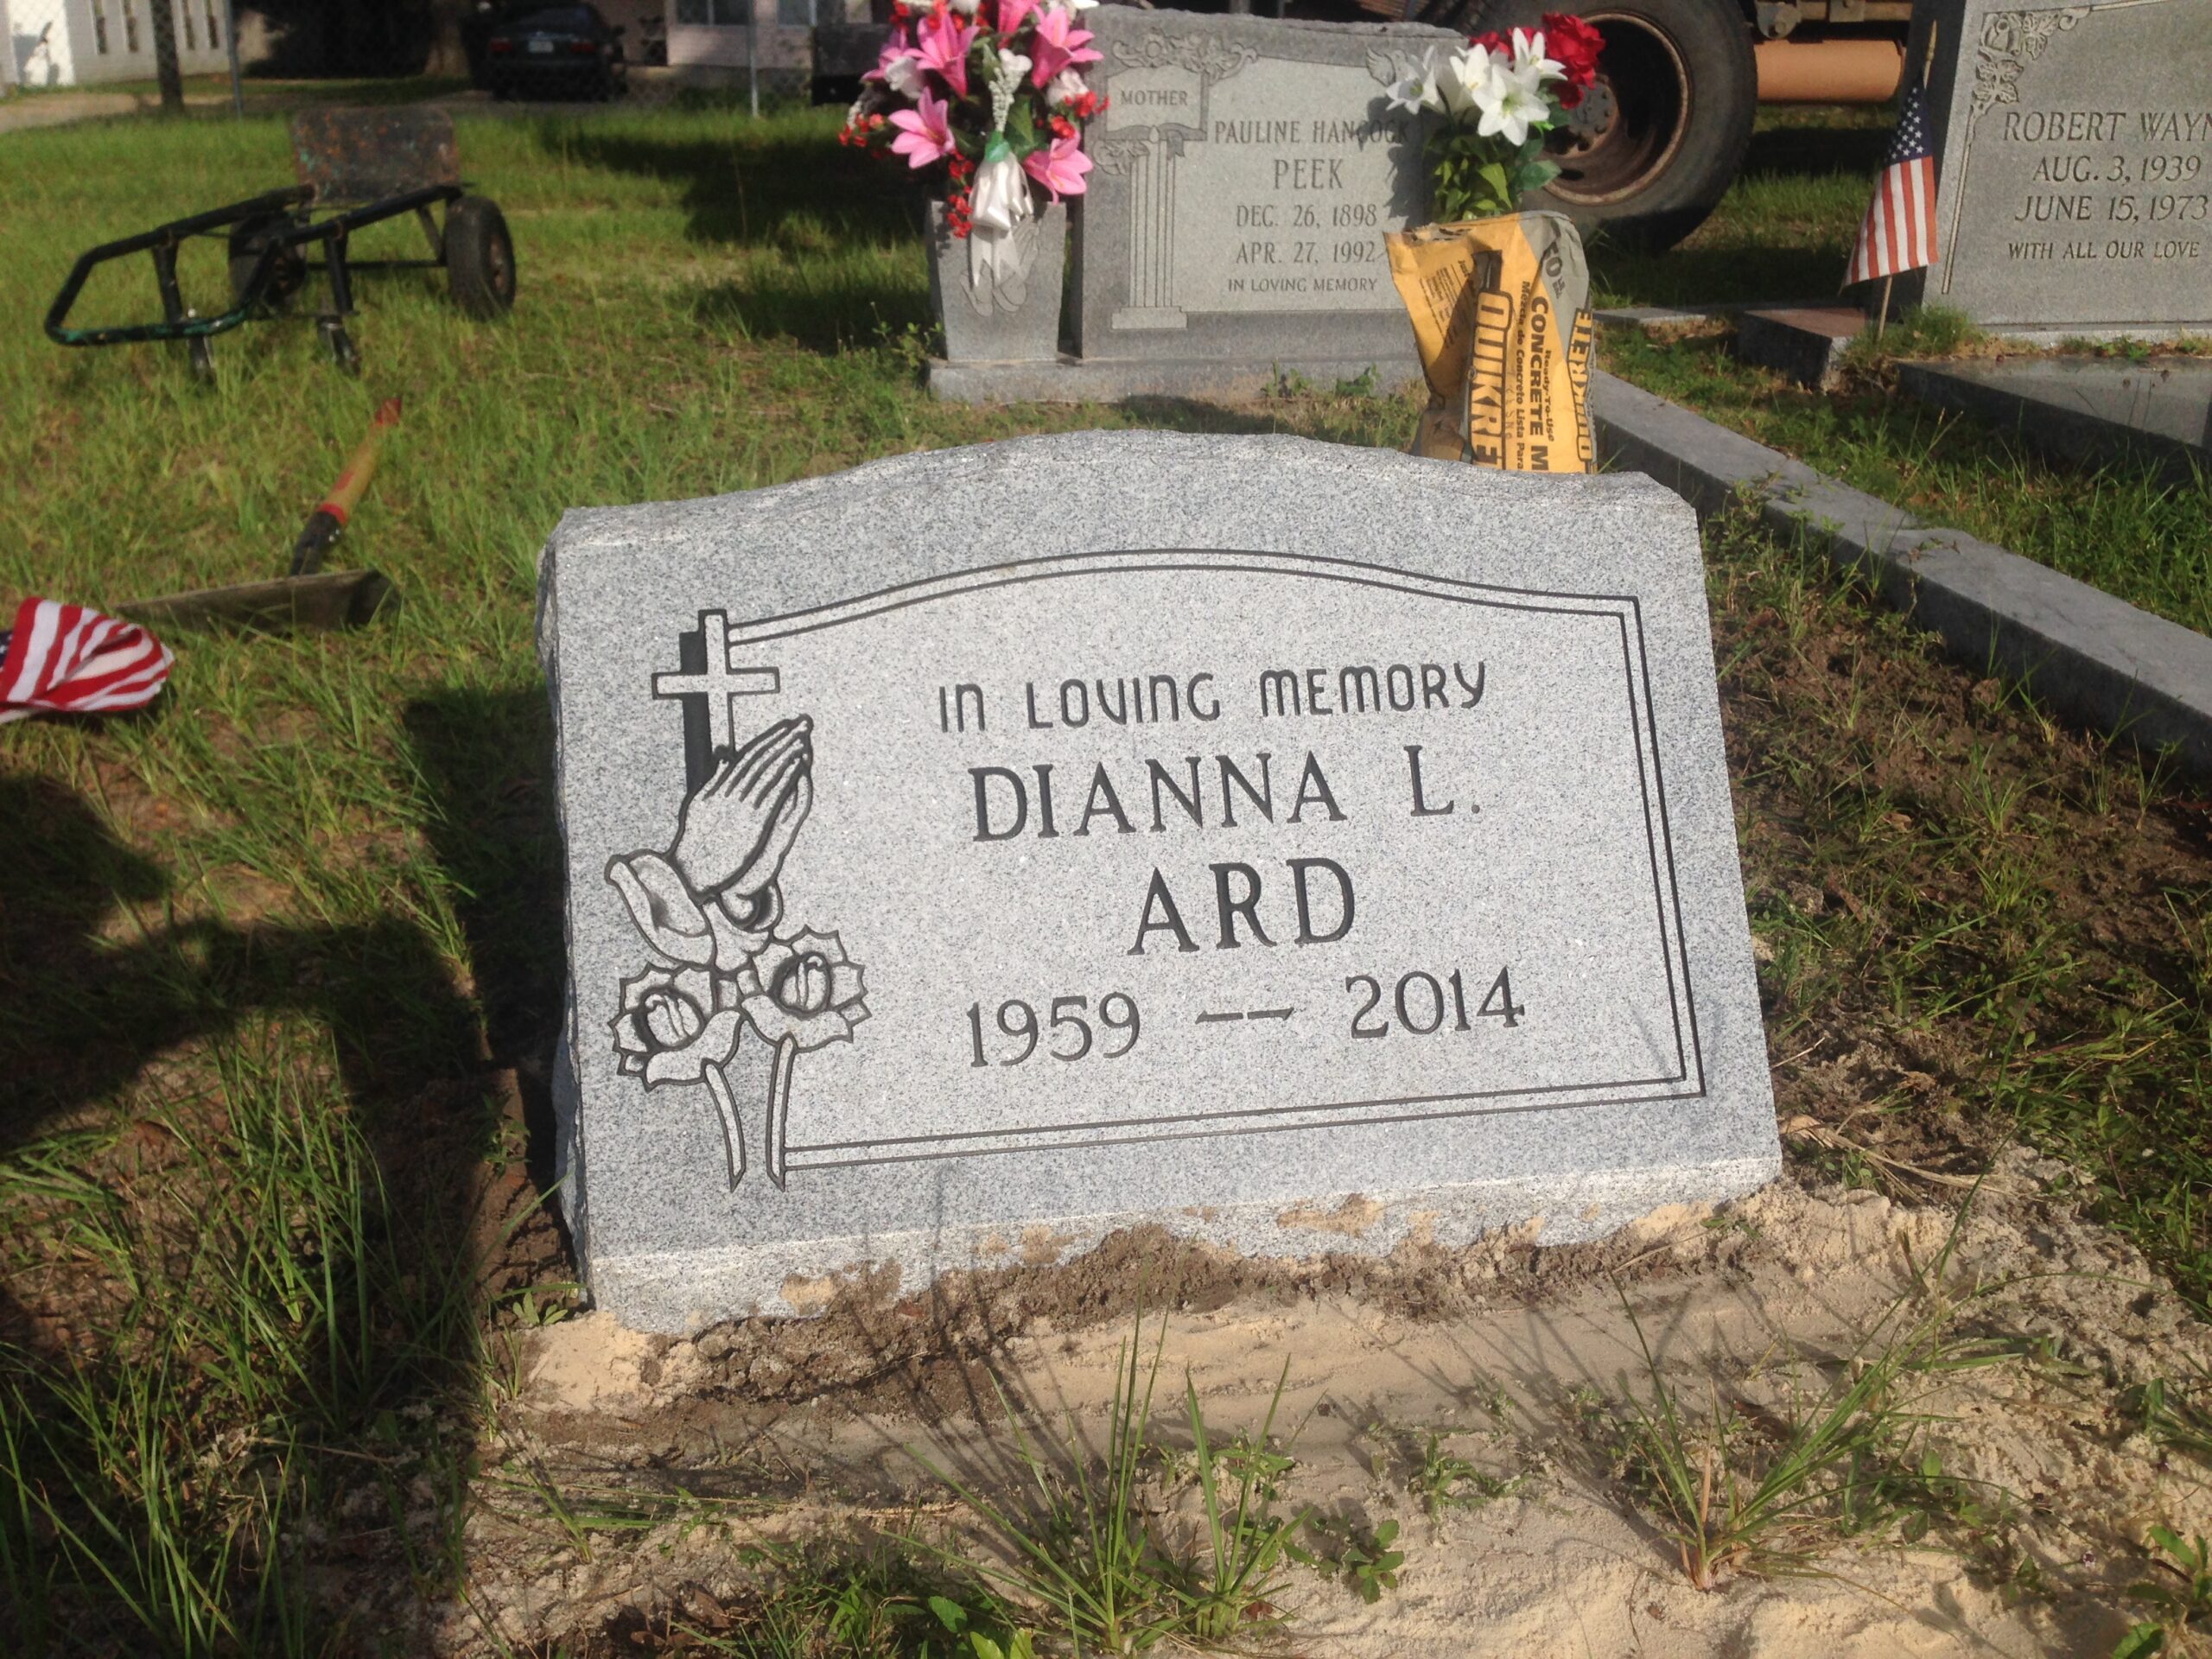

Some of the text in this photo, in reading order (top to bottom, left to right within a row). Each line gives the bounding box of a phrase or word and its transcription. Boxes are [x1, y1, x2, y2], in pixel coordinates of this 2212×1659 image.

[1121, 90, 1188, 106] MOTHER
[1215, 119, 1409, 144] PAULINE HANCOCK
[2003, 111, 2126, 142] ROBERT
[1274, 158, 1344, 190] PEEK
[1236, 204, 1377, 229] DEC. 26, 1898
[2014, 195, 2093, 221] JUNE
[1236, 241, 1376, 265] APR. 27, 1992
[2008, 240, 2200, 259] WITH ALL OUR LOVE
[1228, 277, 1378, 292] IN LOVING MEMORY
[1516, 281, 1530, 469] Mezcla de Concreto Lista Para
[1530, 296, 1549, 435] CONCRETE
[1542, 349, 1554, 442] Ready-To-Use
[939, 661, 1486, 733] IN LOVING MEMORY
[969, 745, 1481, 842] DIANNA L.
[1128, 857, 1355, 956] ARD
[967, 991, 1141, 1068] 1959
[1344, 965, 1525, 1039] 2014
